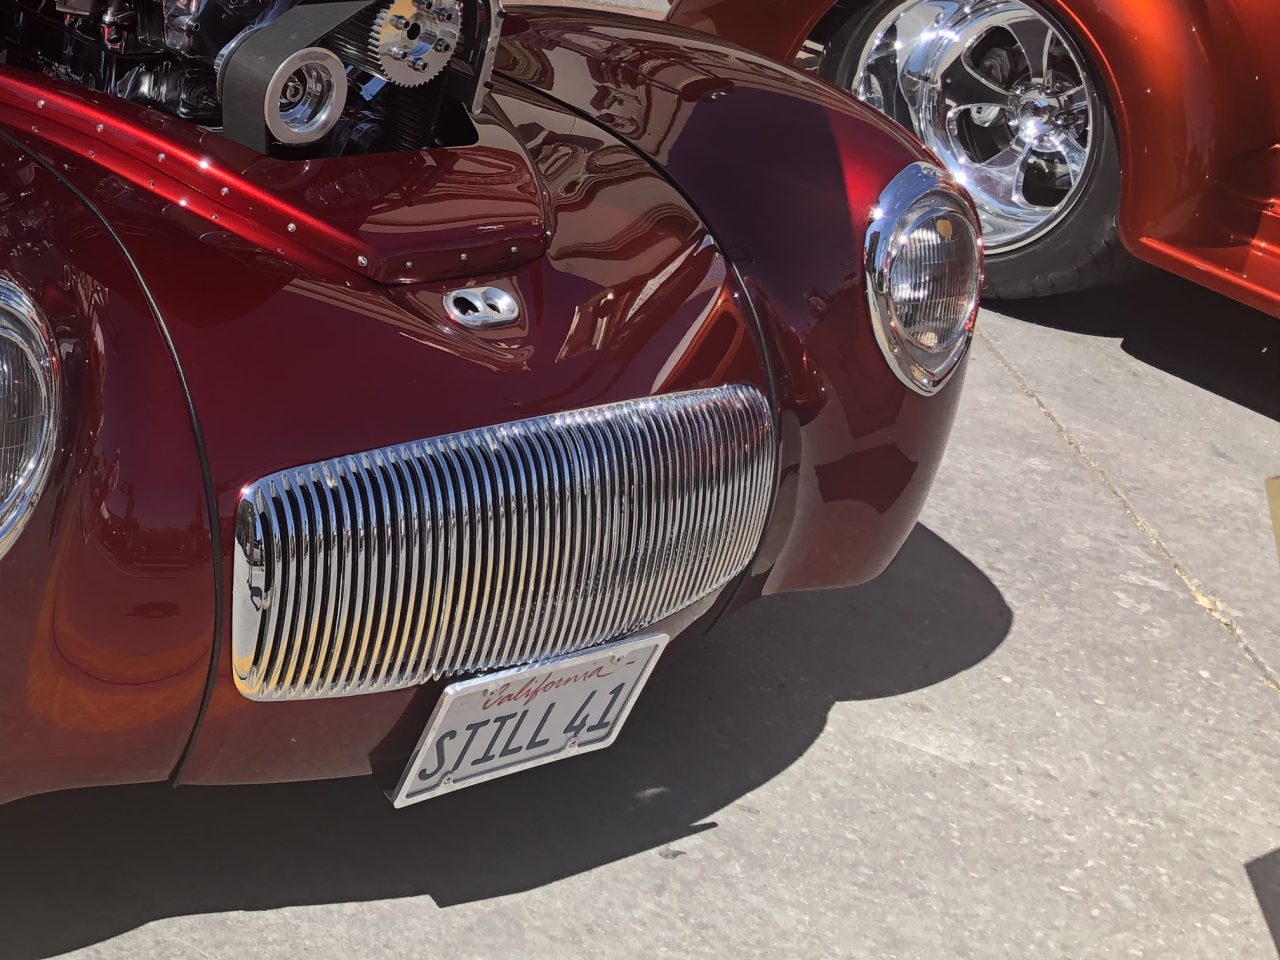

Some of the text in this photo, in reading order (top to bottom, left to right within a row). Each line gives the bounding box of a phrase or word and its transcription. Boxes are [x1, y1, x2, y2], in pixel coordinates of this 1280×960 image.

[482, 665, 612, 711] California
[418, 682, 626, 780] STILL 41
